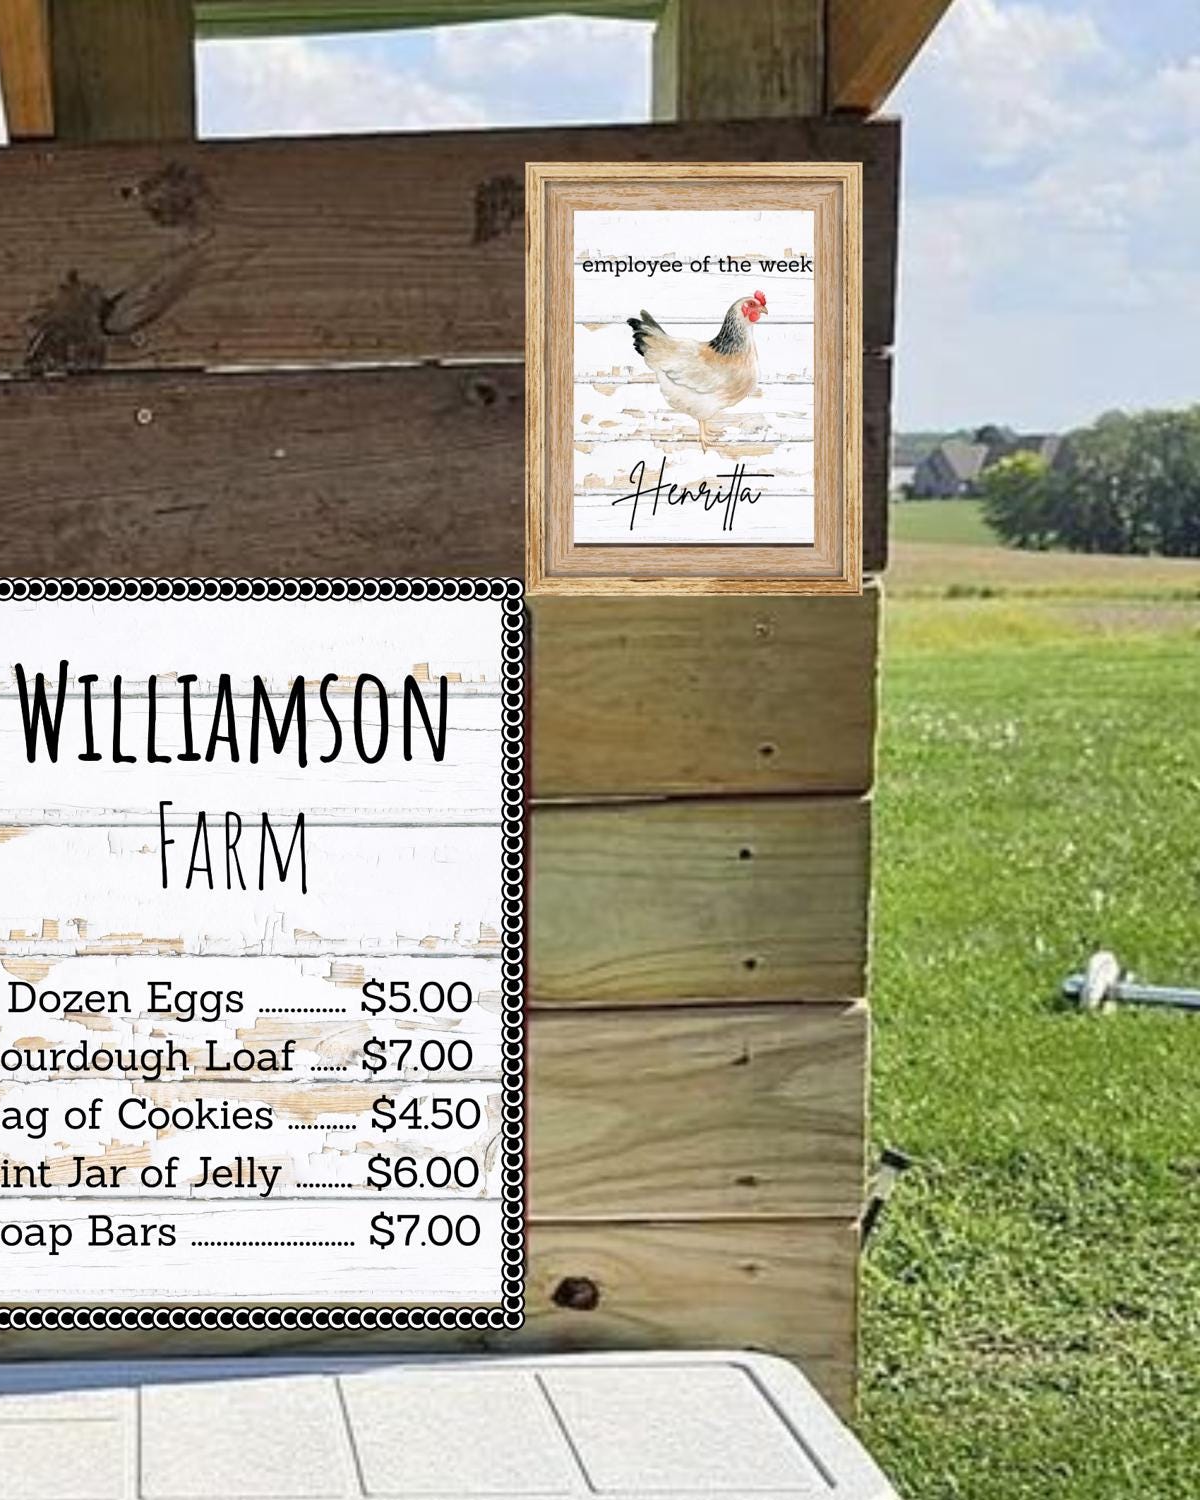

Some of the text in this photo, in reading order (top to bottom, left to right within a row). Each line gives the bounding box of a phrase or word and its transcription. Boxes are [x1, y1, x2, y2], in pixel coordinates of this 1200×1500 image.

[582, 255, 813, 278] employee of the week
[611, 456, 775, 531] Henritta
[8, 981, 132, 1013] Dozen
[147, 981, 244, 1023] Eggs
[361, 977, 472, 1017] $5.00
[205, 1039, 296, 1072] Loaf
[362, 1036, 473, 1075] $7.00
[64, 1097, 104, 1130] of
[118, 1098, 273, 1130] Cookies
[371, 1094, 481, 1133] $4.50
[67, 1156, 127, 1188] Jar
[140, 1156, 180, 1188] of
[194, 1156, 282, 1198] Jelly
[367, 1152, 479, 1192] $6.00
[88, 1214, 176, 1247] Bars
[370, 1211, 481, 1250] $7.00
